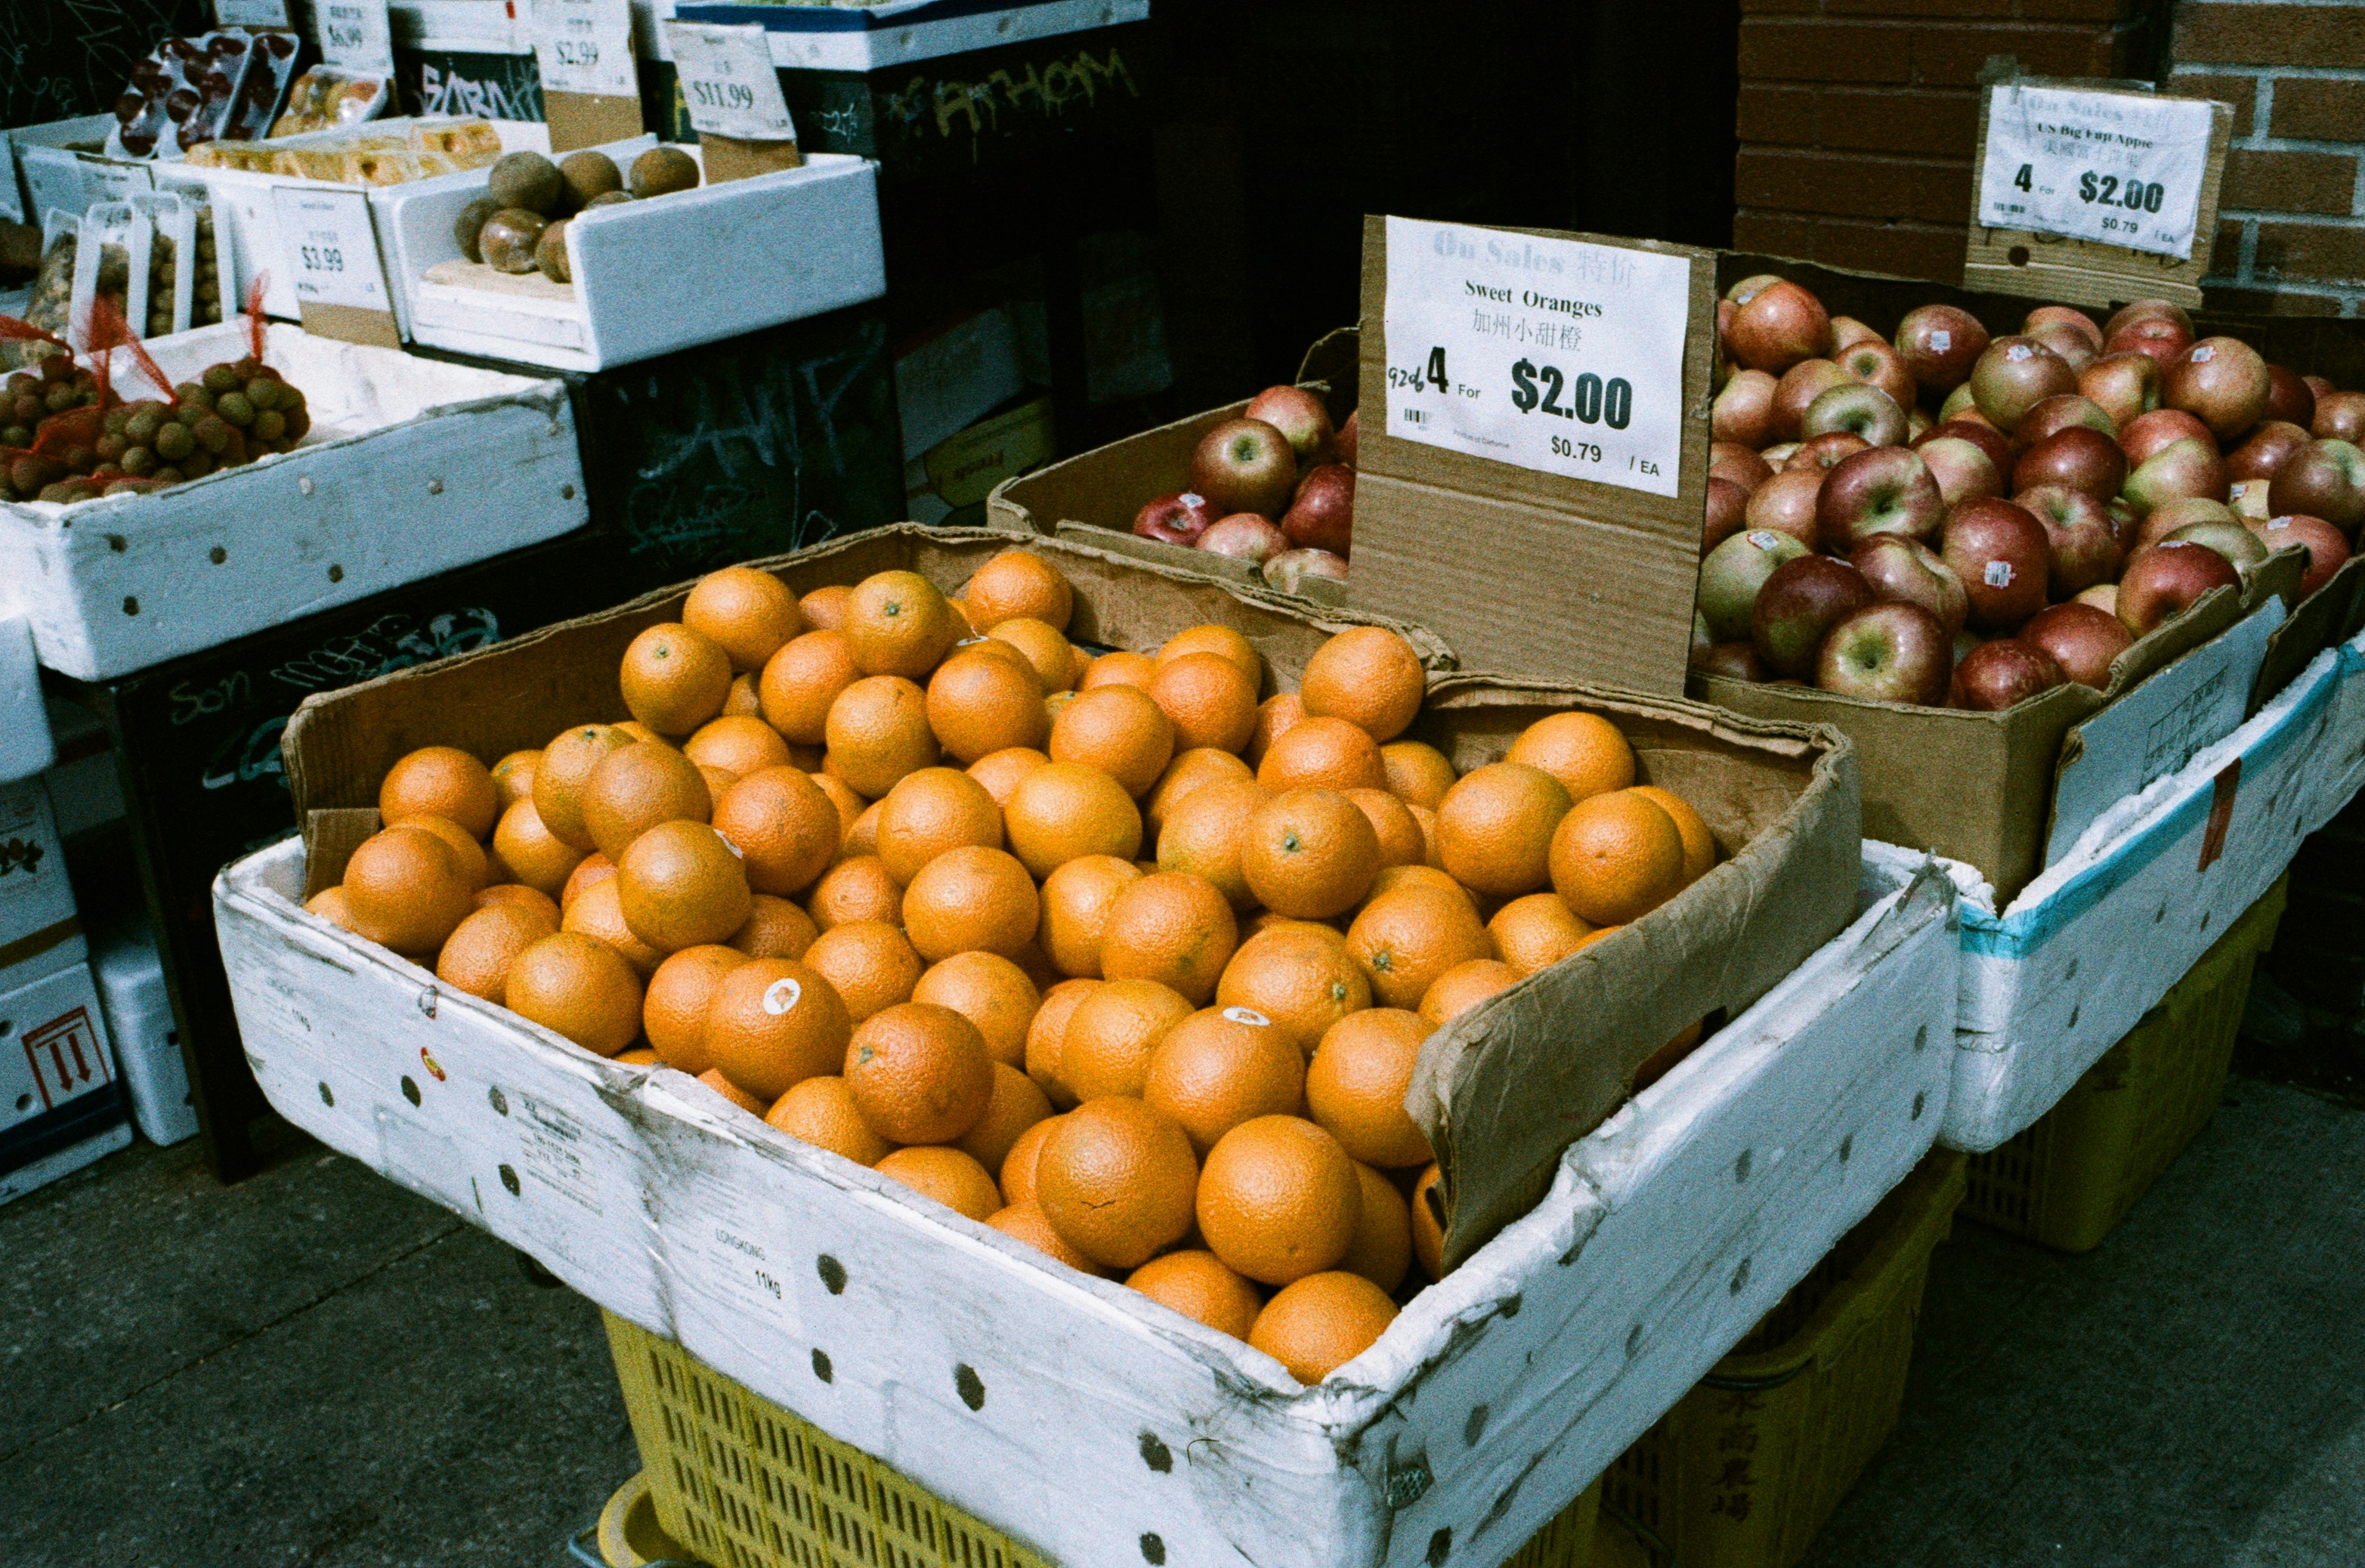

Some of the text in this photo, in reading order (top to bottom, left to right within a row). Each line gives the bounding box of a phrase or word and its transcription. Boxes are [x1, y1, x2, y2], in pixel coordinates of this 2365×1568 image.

[692, 79, 754, 111] $11.99
[2060, 124, 2082, 140] Big
[2014, 162, 2033, 193] 4
[2079, 170, 2165, 214] $2.00
[2101, 216, 2139, 234] $0.79
[301, 246, 344, 272] $3.99
[1486, 238, 1564, 275] Sales
[1464, 279, 1603, 320] Sweet Oranges
[1471, 308, 1583, 352] 加州小甜橙
[1427, 345, 1633, 431] 4 For $2.00
[1550, 435, 1602, 463] $0.79
[1640, 459, 1660, 477] EA
